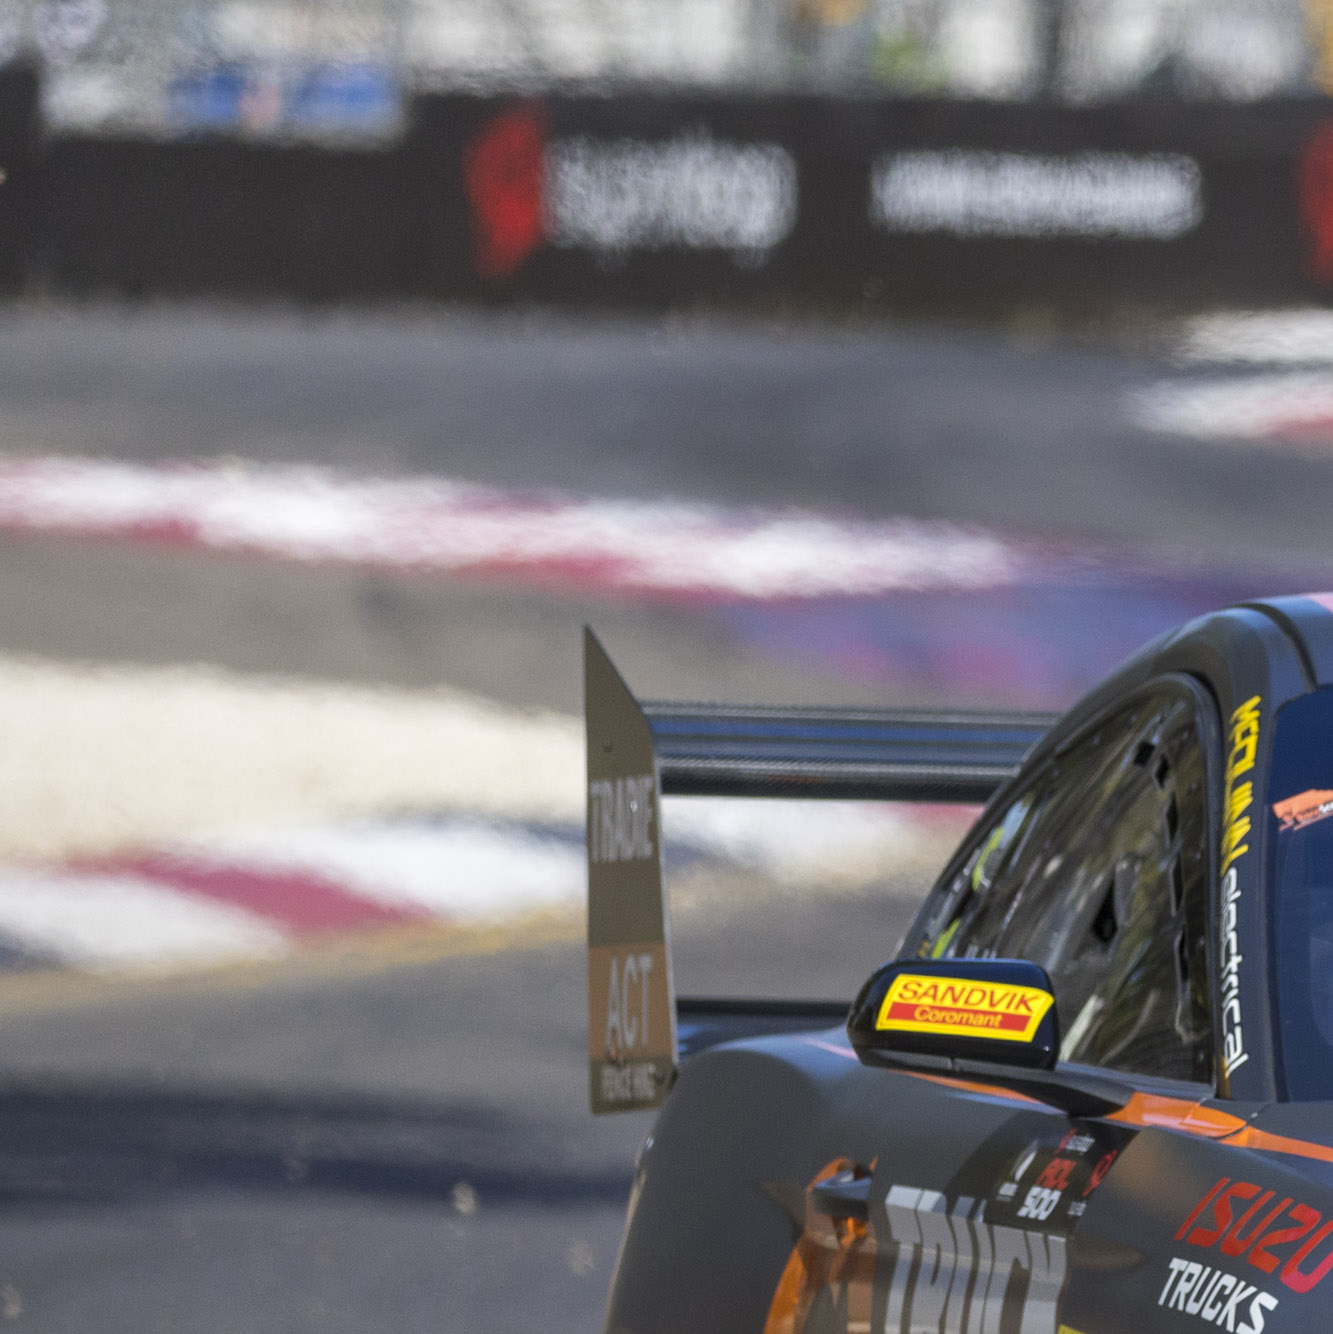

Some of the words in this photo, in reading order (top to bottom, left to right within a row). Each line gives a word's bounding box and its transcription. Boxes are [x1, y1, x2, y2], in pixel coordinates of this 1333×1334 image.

[1220, 867, 1249, 1078] electrical
[898, 981, 1039, 1013] SANDVIK
[913, 1005, 1003, 1028] Coromant
[1017, 1185, 1062, 1220] 500
